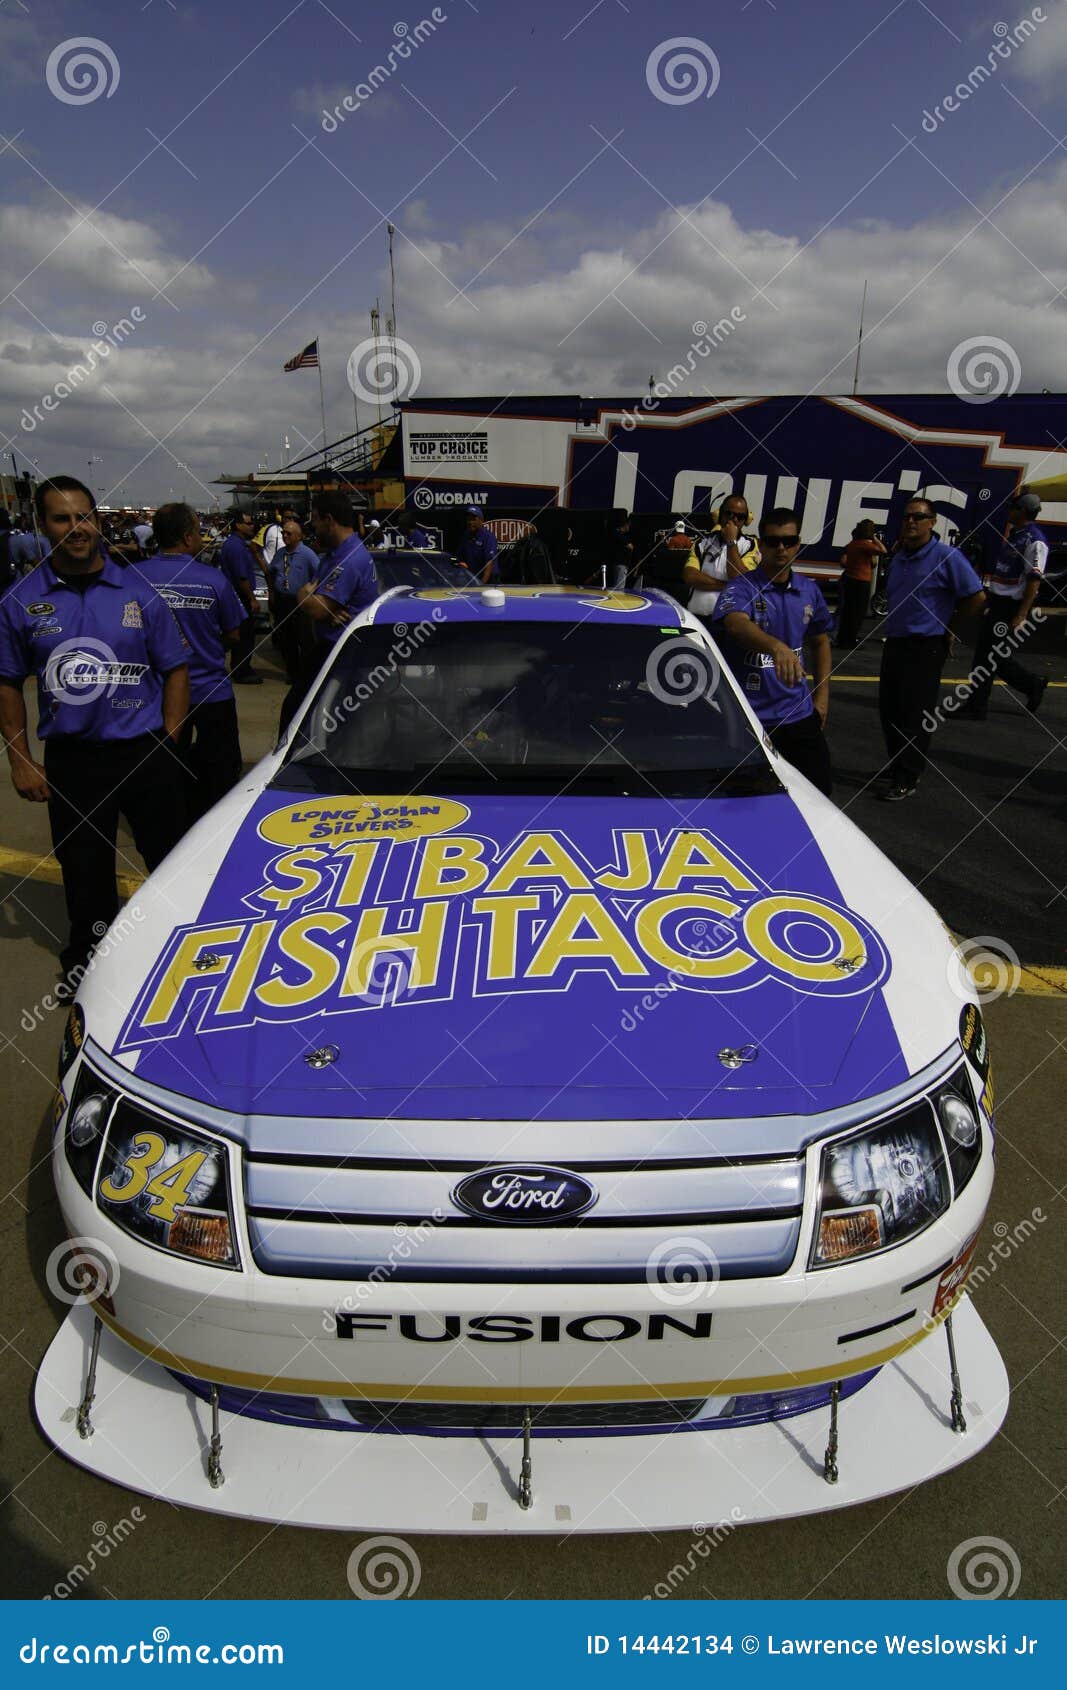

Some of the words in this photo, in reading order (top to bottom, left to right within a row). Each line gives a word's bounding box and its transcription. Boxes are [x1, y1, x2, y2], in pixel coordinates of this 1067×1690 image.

[410, 441, 436, 454] TOP
[439, 441, 488, 455] CHOICE
[434, 492, 488, 505] KOBALT
[257, 841, 377, 911] $1
[413, 831, 759, 899] BAJA
[139, 900, 450, 1028] FISH
[472, 892, 866, 983] TACO
[99, 1131, 210, 1224] 34
[482, 1172, 570, 1209] Ford
[335, 1312, 713, 1343] FUSION
